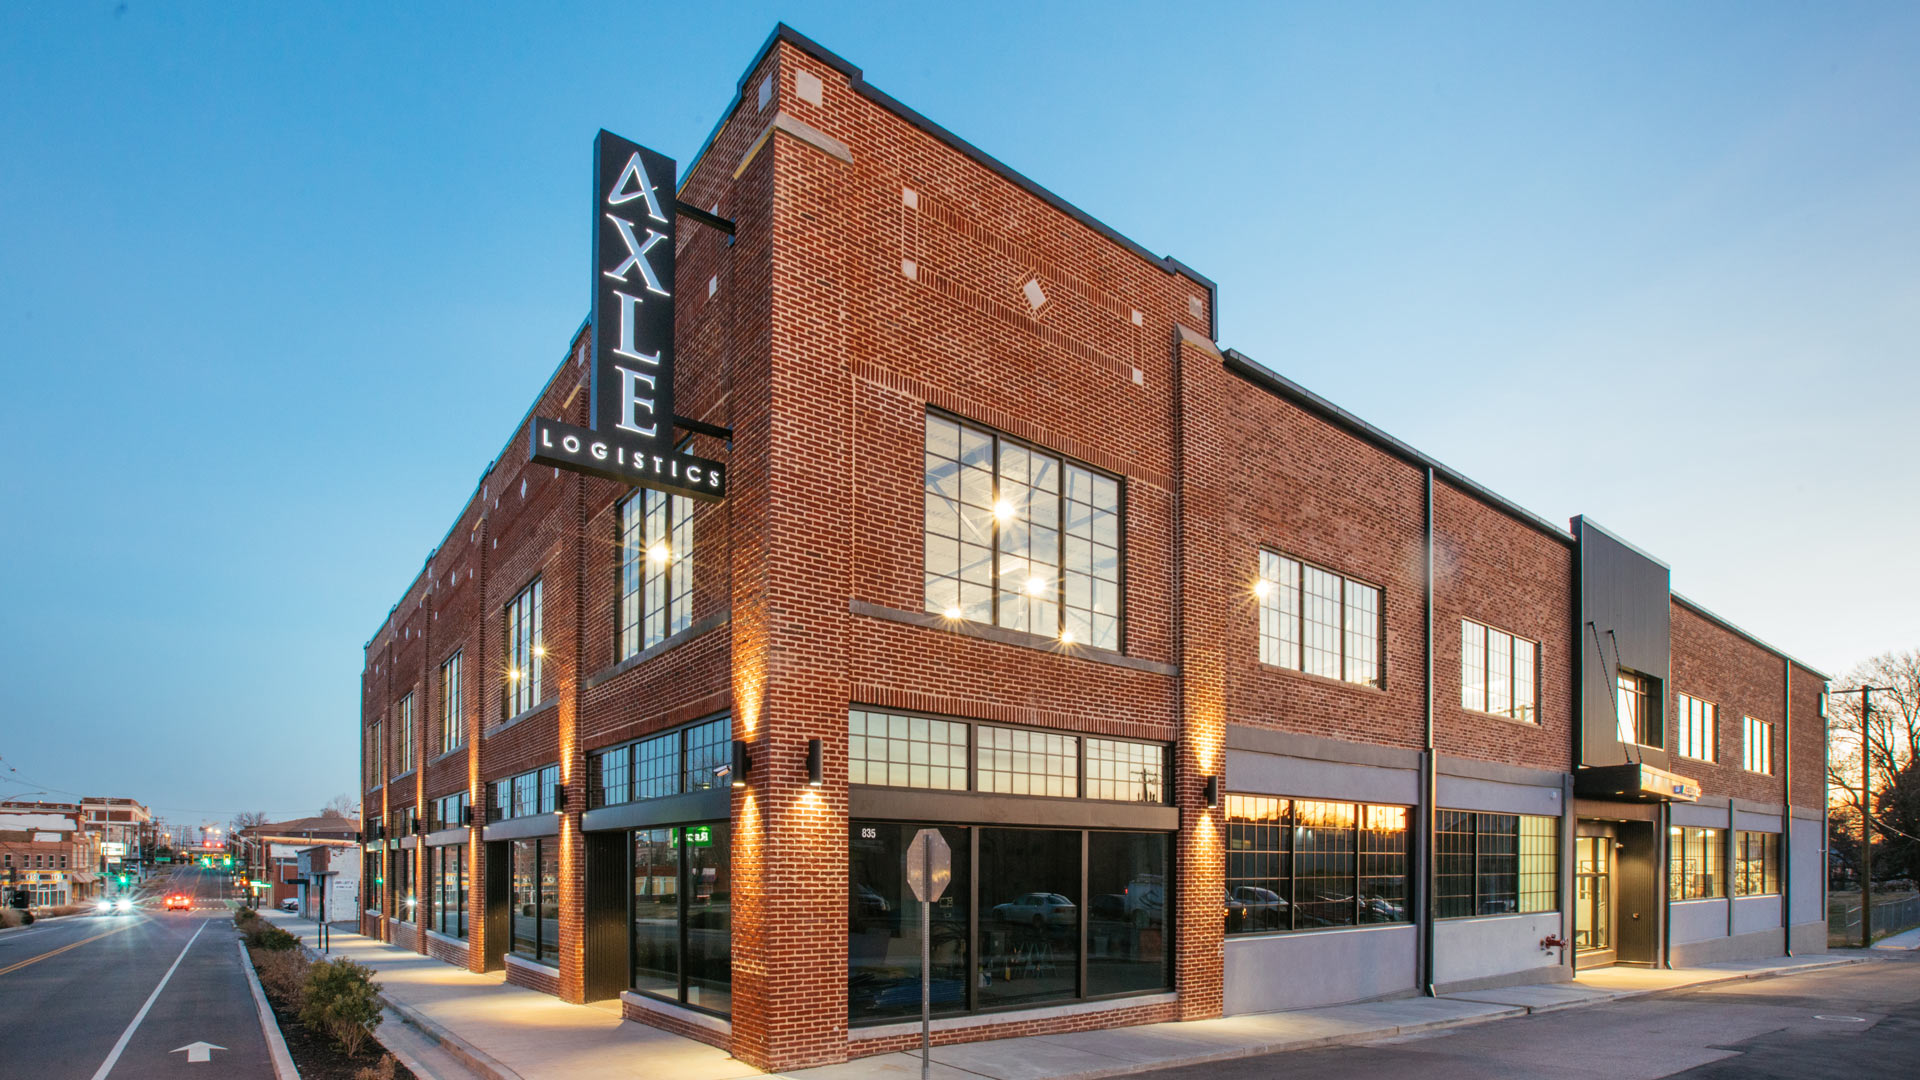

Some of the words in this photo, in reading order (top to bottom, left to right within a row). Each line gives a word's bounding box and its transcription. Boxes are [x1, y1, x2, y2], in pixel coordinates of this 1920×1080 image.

[603, 151, 671, 437] AXLE
[542, 428, 720, 487] LOGISTICS
[861, 827, 876, 839] 835
